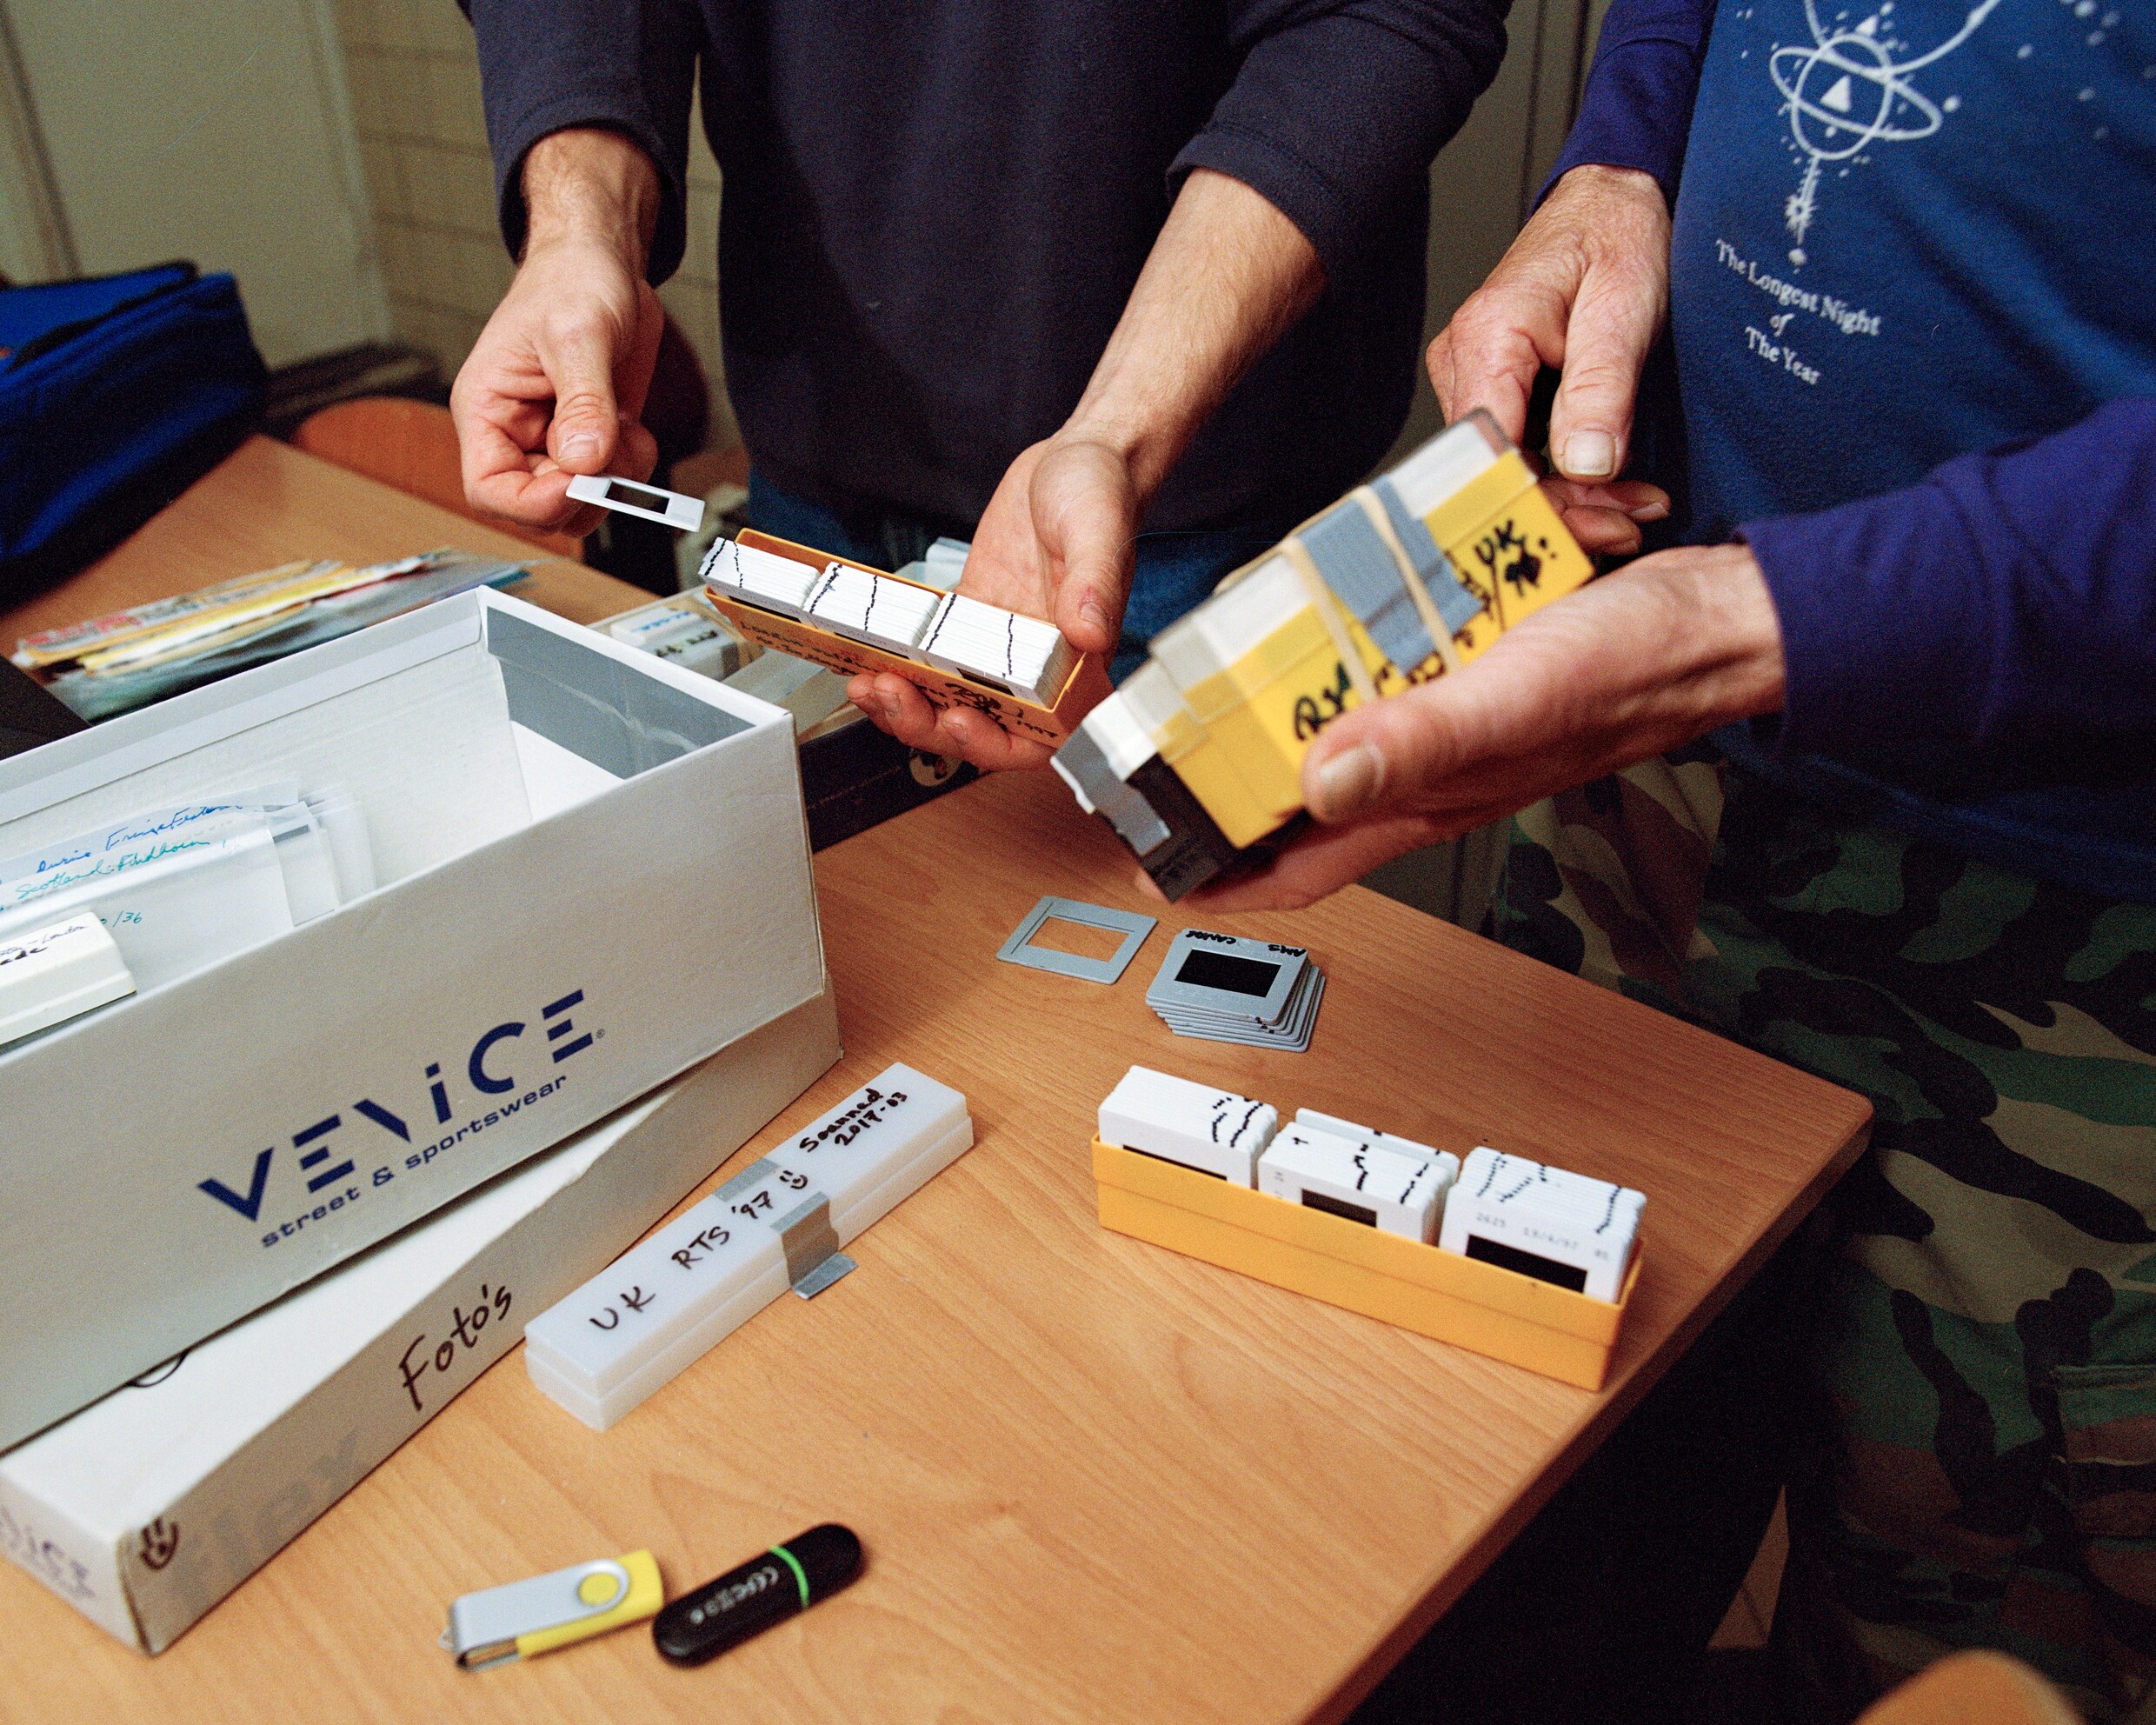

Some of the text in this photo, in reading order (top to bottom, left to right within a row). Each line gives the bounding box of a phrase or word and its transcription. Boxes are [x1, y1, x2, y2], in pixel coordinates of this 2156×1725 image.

[1715, 239, 1882, 336] The Longest Night
[1769, 313, 1795, 336] of
[1745, 326, 1821, 385] The Year
[261, 1074, 569, 1248] street & sportswear
[590, 1190, 775, 1332] UK RTS '97
[398, 1283, 513, 1411] Foto's
